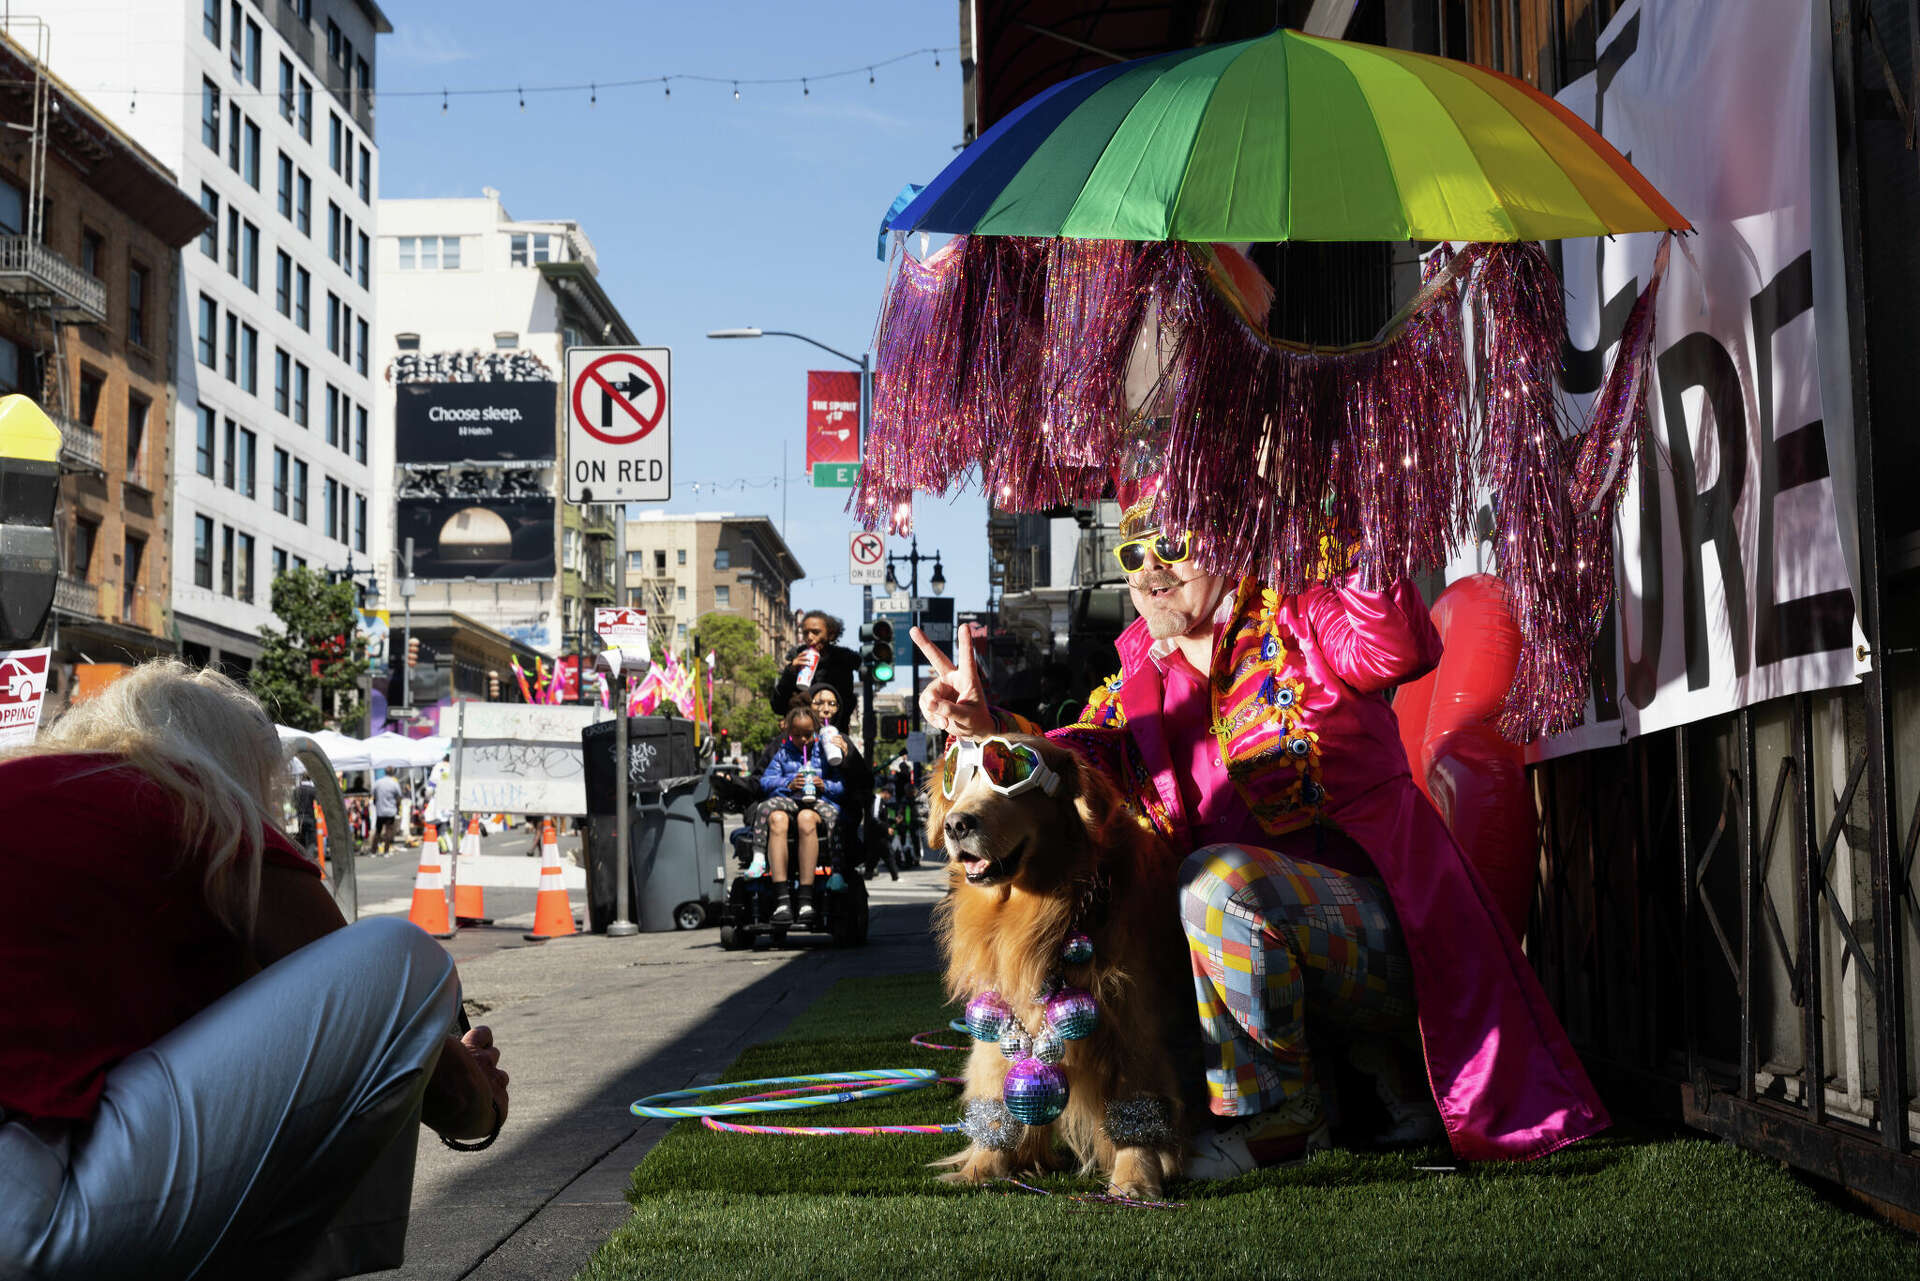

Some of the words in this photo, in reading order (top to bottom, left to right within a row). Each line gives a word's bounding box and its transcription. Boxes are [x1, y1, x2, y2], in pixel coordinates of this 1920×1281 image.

[429, 406, 480, 422] Choose
[482, 406, 523, 424] sleep.
[468, 426, 493, 436] Hatch
[575, 461, 606, 483] ON
[619, 459, 663, 482] RED
[852, 569, 864, 578] ON
[867, 569, 882, 578] RED
[880, 600, 923, 610] ELLIS
